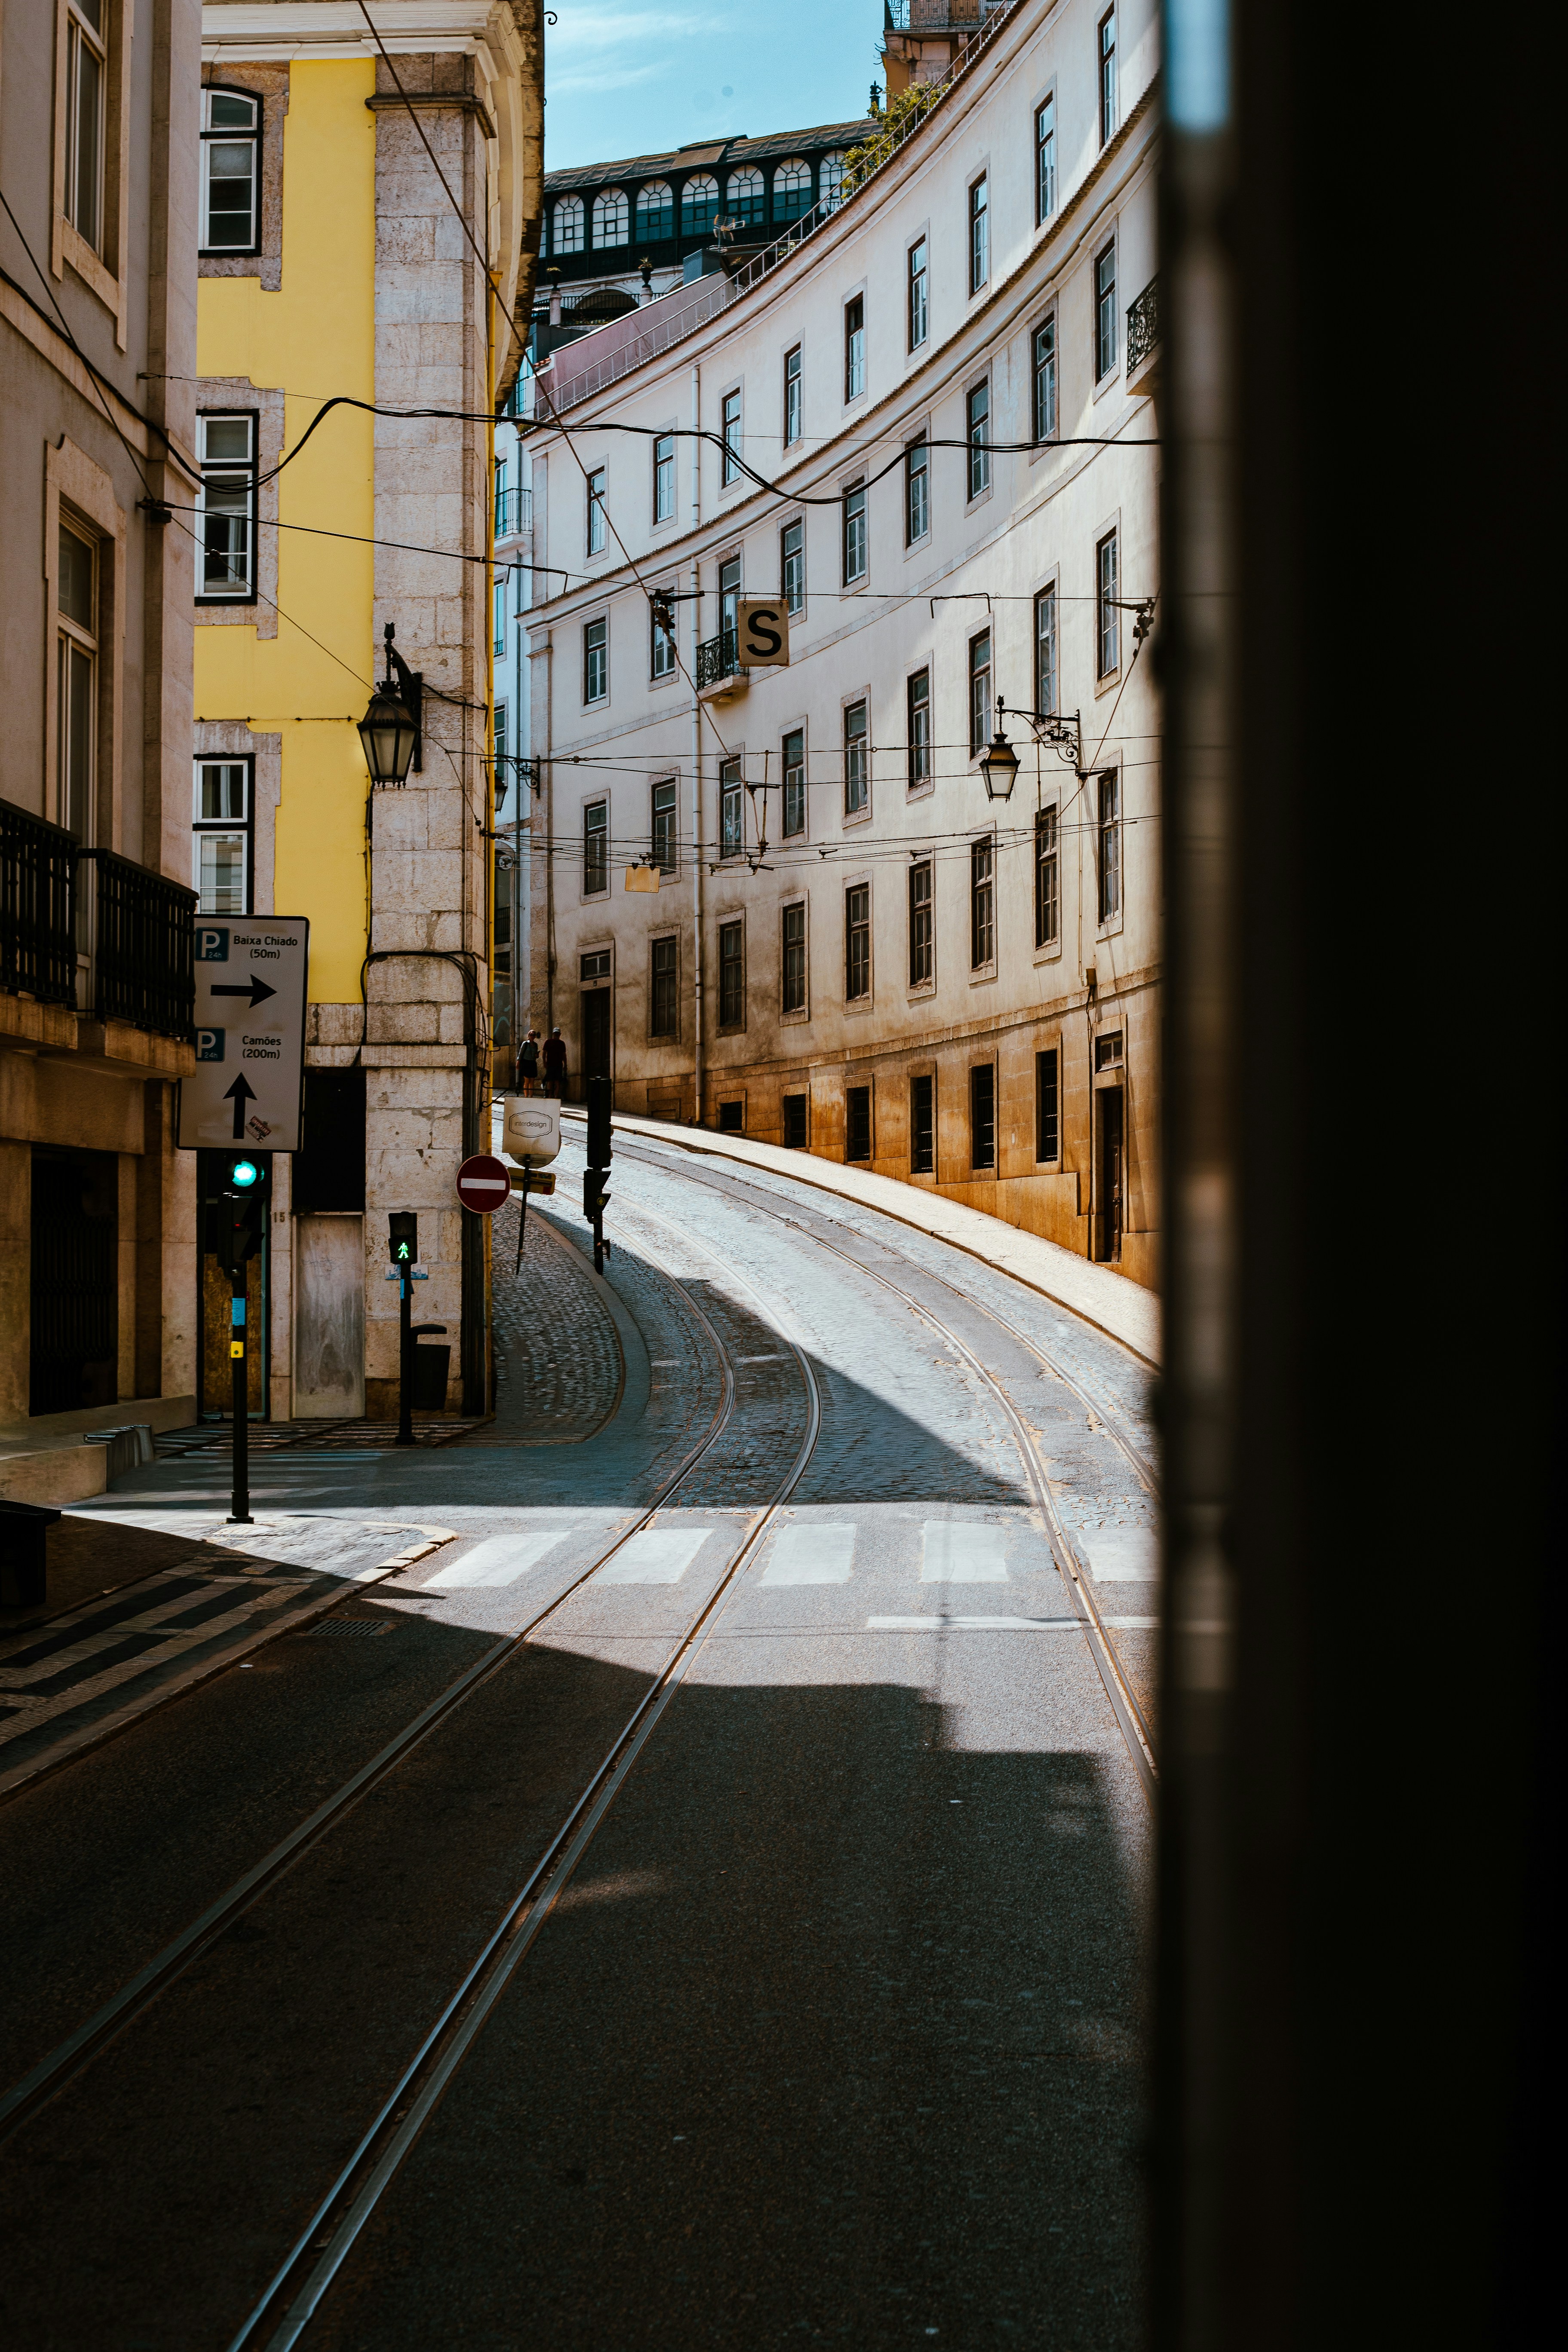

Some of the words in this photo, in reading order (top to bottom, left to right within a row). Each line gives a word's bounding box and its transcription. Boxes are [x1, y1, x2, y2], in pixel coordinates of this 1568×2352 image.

[745, 609, 782, 657] S
[201, 931, 220, 958] P
[233, 935, 262, 945] Baixa
[264, 936, 298, 946] Chiado
[250, 949, 281, 959] (50m)
[197, 1031, 216, 1058] P
[242, 1035, 282, 1046] Camões
[242, 1048, 280, 1060] (200m)
[514, 1120, 547, 1129] interdesign
[274, 1212, 285, 1223] 15
